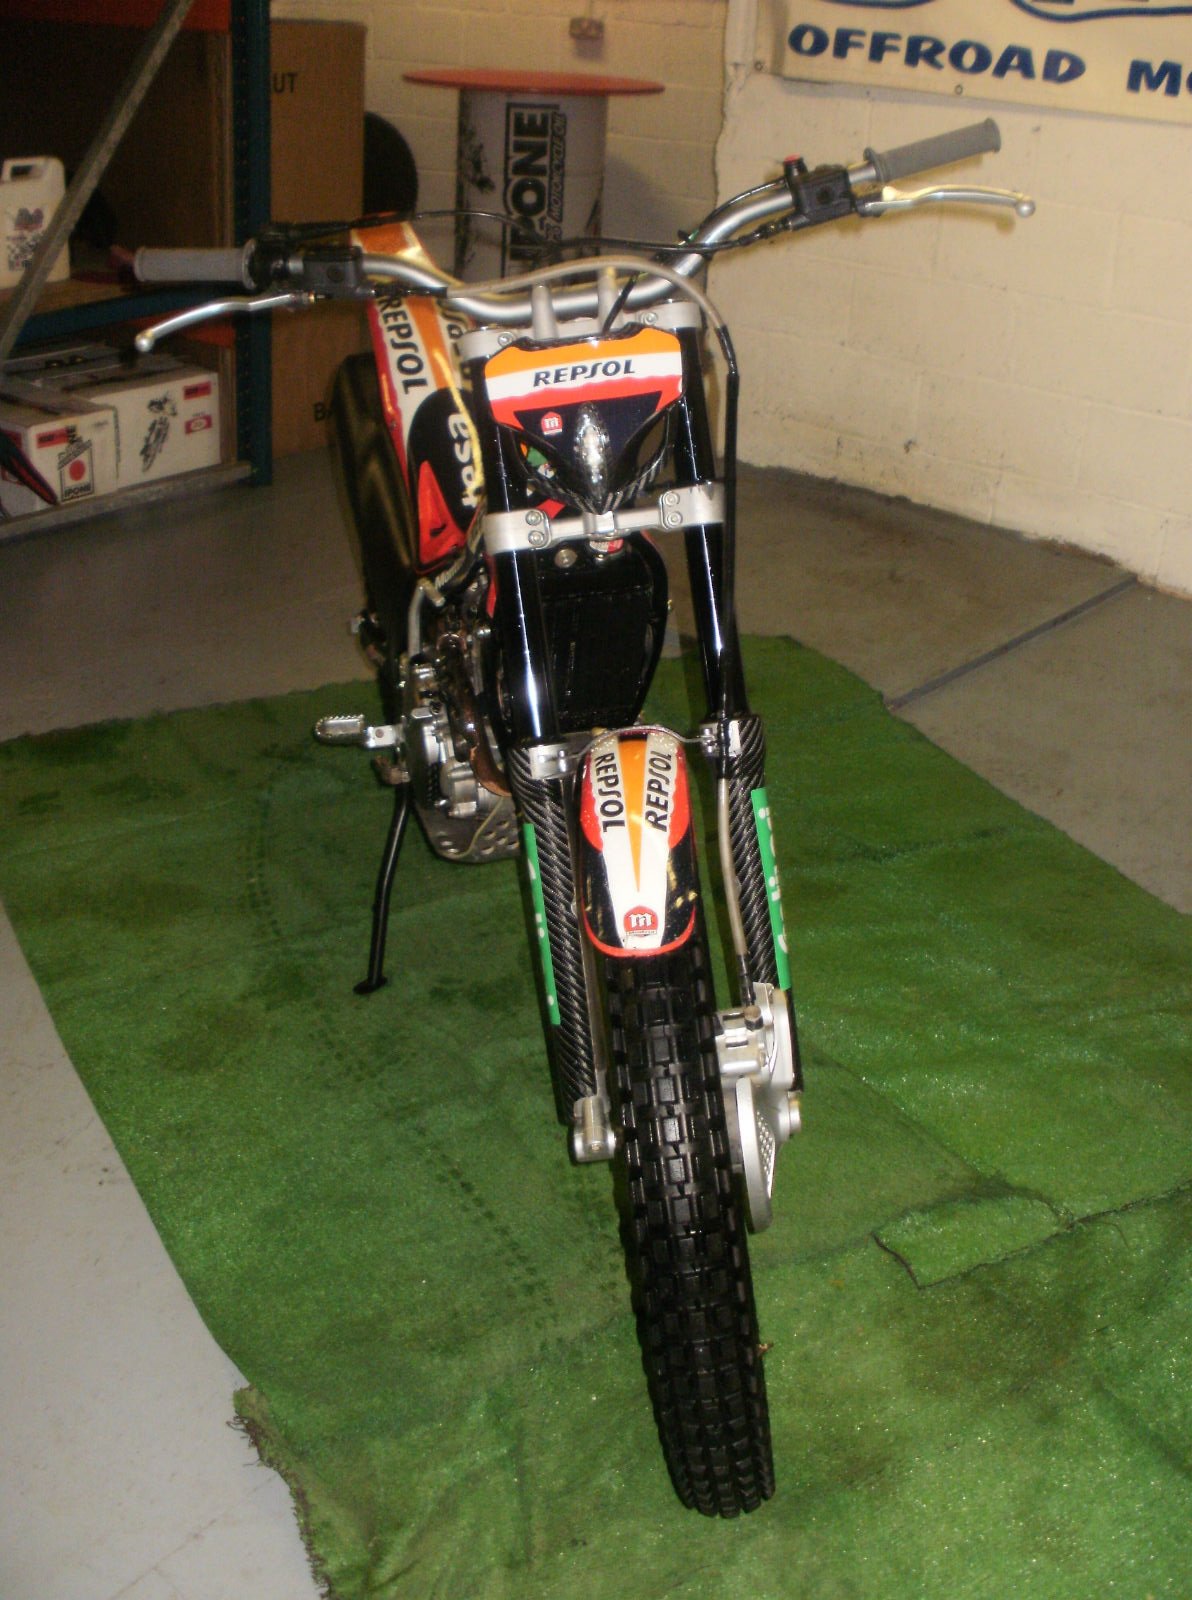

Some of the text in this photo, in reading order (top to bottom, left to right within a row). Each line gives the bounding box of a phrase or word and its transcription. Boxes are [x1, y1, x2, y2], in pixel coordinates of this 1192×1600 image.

[788, 23, 1192, 98] OFFROAD M
[379, 297, 428, 395] REPSOL
[533, 359, 635, 387] REPSOL
[595, 752, 626, 833] REPSOL
[644, 750, 672, 833] REPSOL
